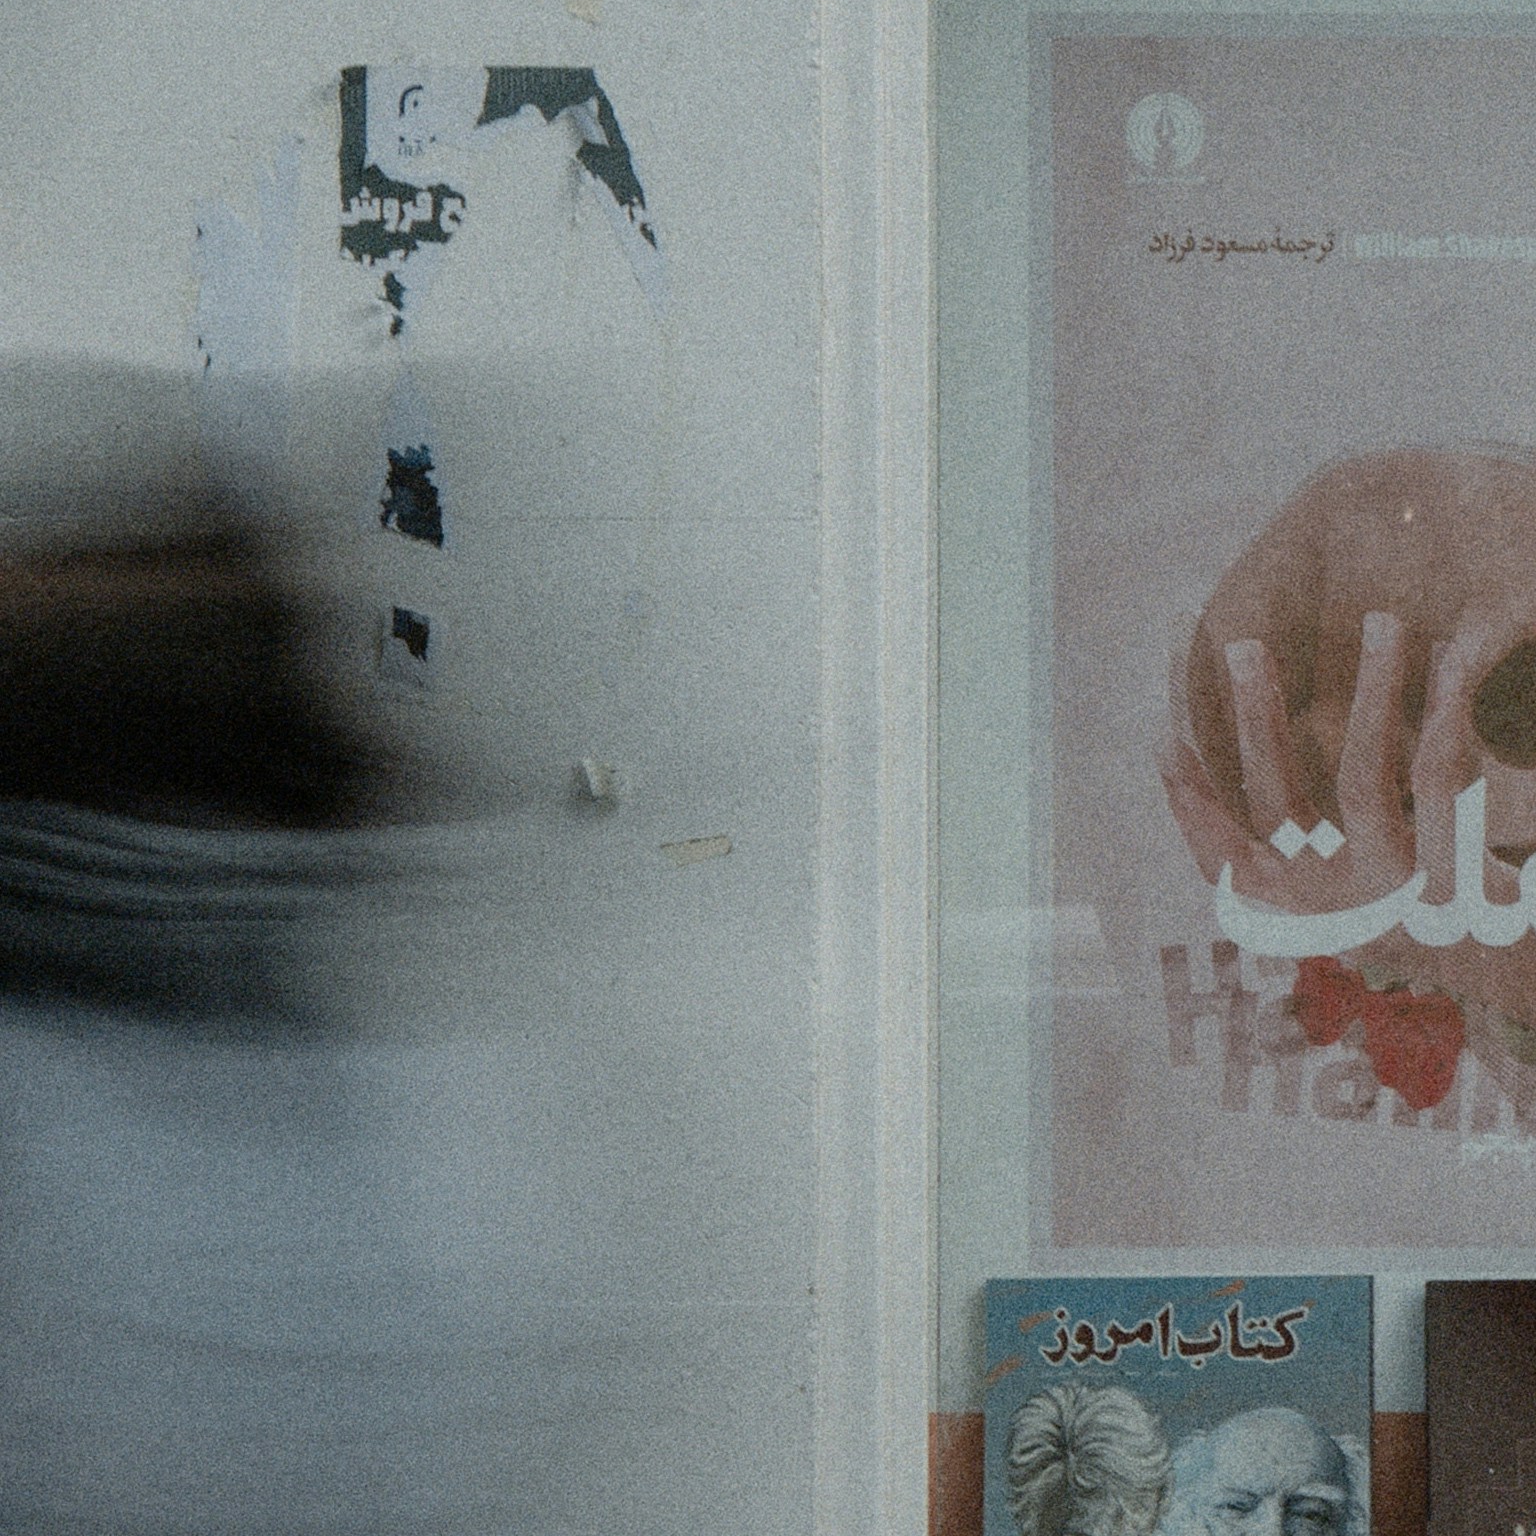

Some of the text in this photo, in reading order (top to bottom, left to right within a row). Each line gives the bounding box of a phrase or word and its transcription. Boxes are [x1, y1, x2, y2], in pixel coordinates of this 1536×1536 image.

[1148, 228, 1195, 263] فرزاد
[1200, 234, 1268, 262] مسعود
[1042, 1302, 1306, 1367] کتاب امروز
